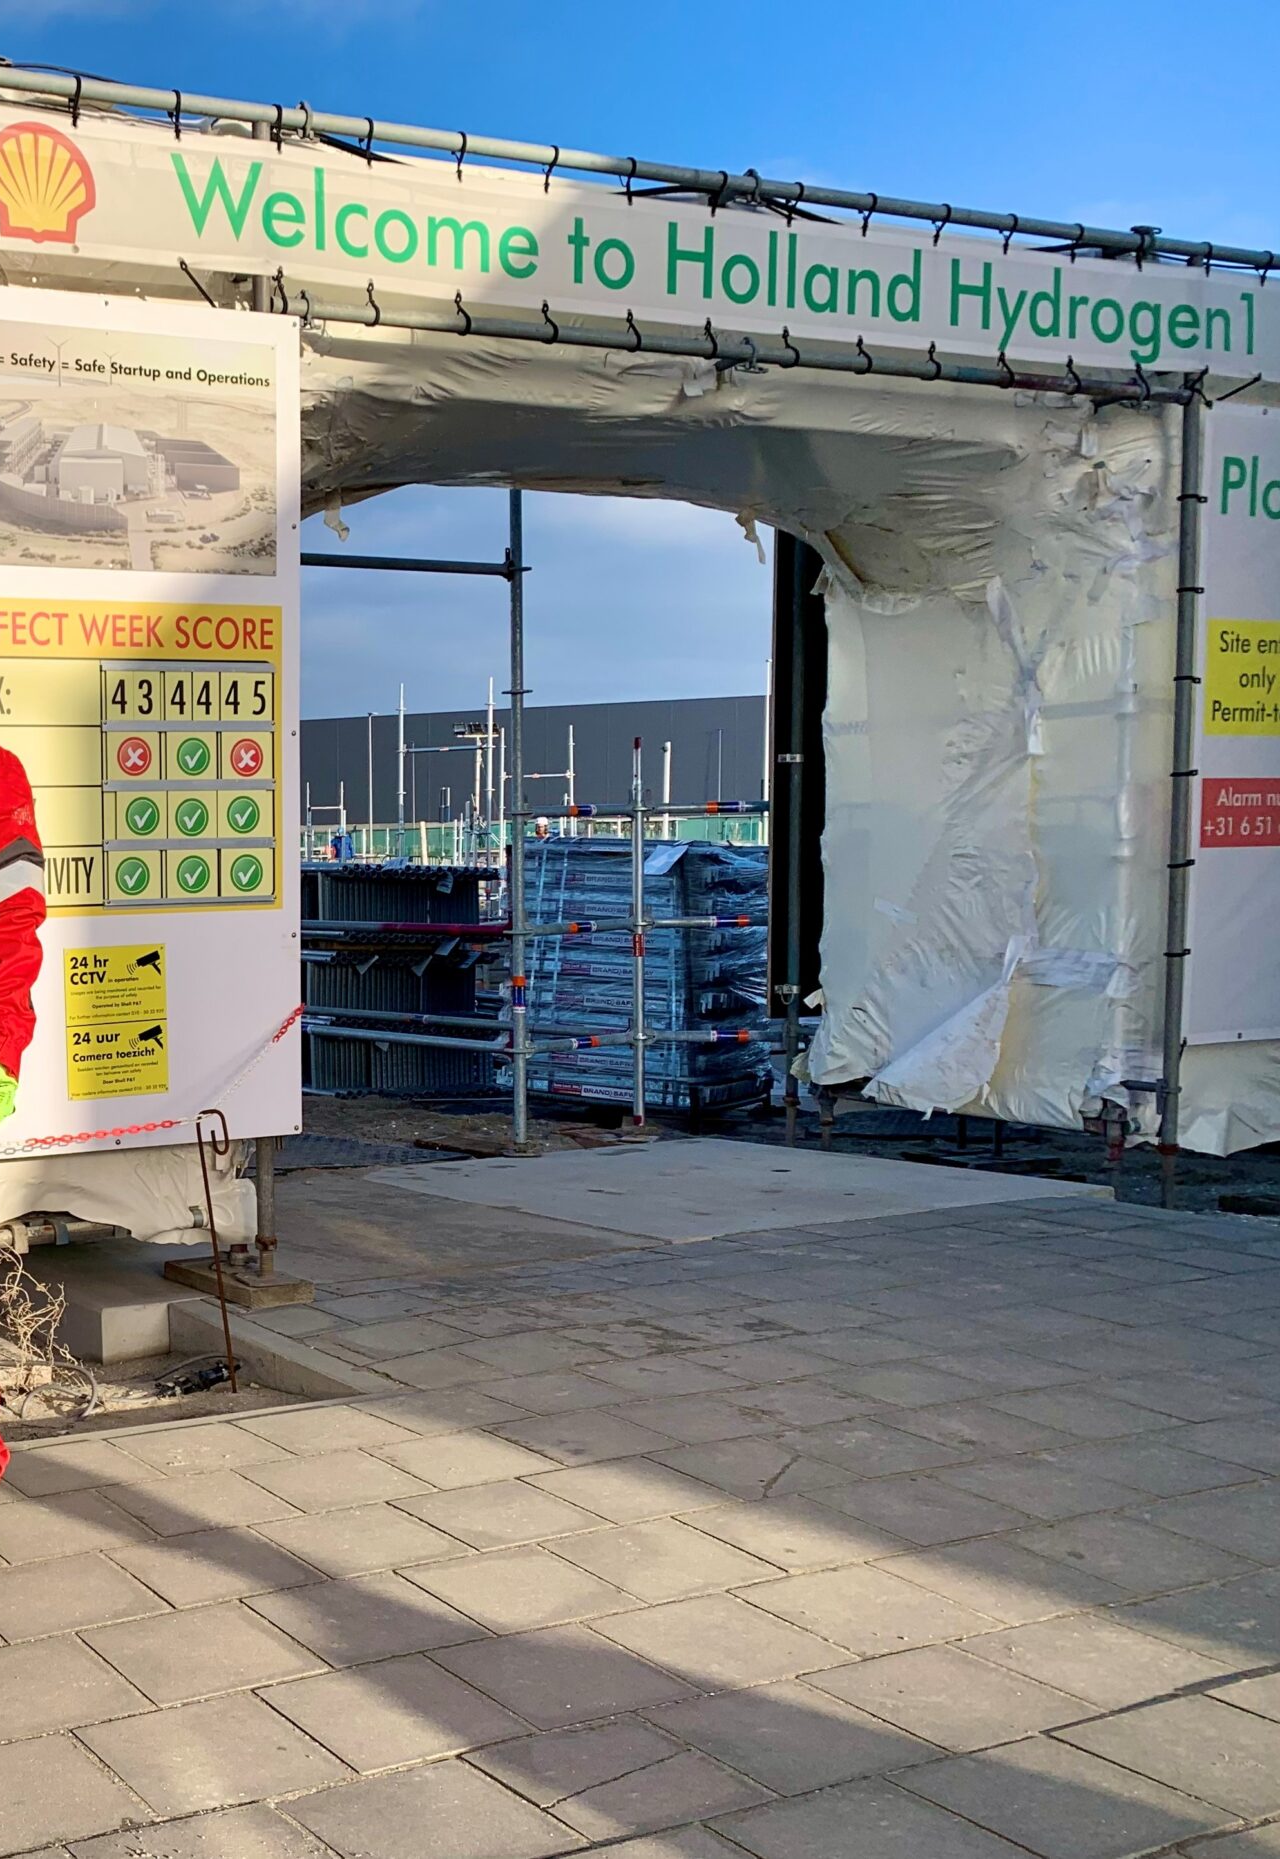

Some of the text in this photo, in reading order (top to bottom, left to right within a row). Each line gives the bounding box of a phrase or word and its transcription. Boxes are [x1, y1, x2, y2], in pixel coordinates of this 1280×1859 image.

[170, 152, 539, 280] Welcome
[568, 216, 635, 290] to
[666, 221, 922, 323] Holland
[10, 353, 56, 372] Safety
[74, 358, 105, 374] Safe
[110, 362, 161, 381] Startup
[166, 366, 192, 381] and
[197, 368, 270, 388] Operations
[79, 614, 164, 649] WEEK
[175, 615, 274, 651] SCORE
[1220, 630, 1251, 654] Site
[1239, 666, 1276, 694] only
[111, 679, 266, 715] 43 44 45
[1217, 786, 1262, 806] Alarm
[1204, 816, 1272, 836] +31 6 51
[45, 857, 94, 895] IVITY
[70, 954, 109, 970] 24 hr
[70, 971, 106, 985] CCTV
[73, 1032, 121, 1046] 24 uur
[72, 1046, 155, 1063] Camera toezicht
